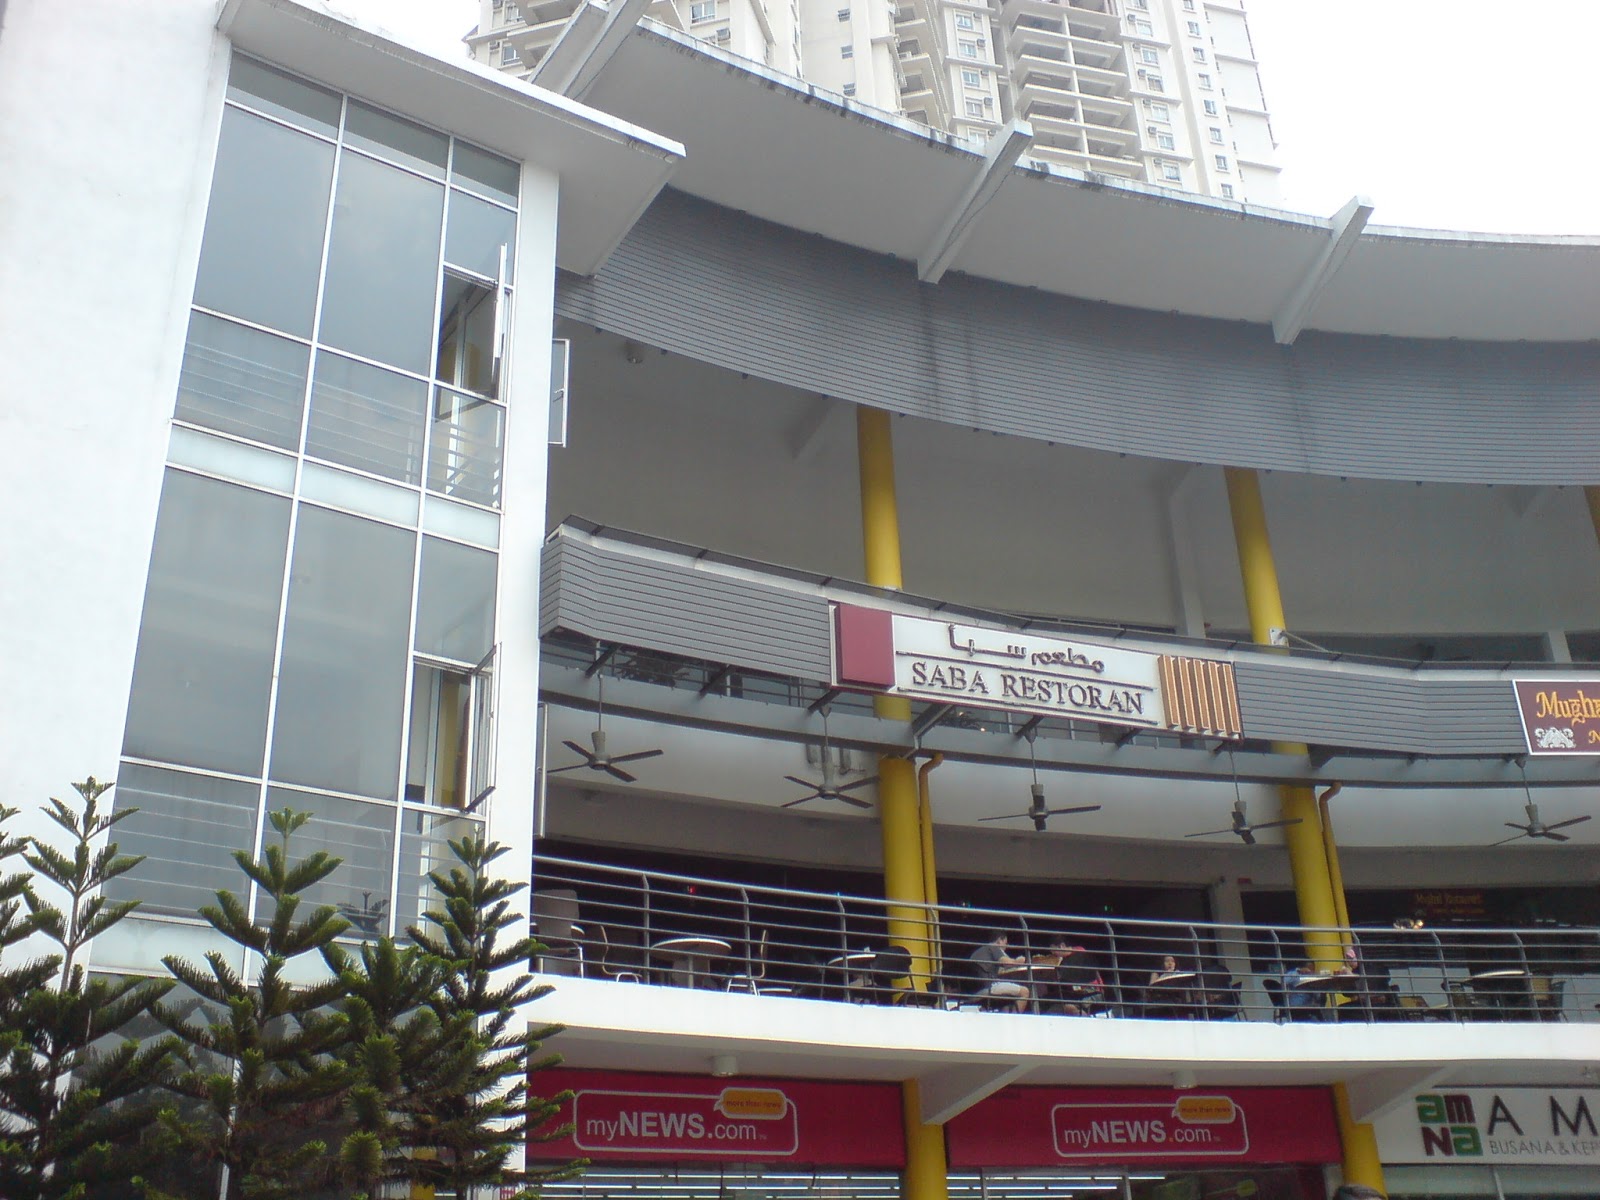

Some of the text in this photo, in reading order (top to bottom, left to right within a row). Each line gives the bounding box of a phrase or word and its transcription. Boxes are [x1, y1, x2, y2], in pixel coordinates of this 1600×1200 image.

[912, 661, 1144, 715] SABA RESTORAN
[586, 1111, 757, 1141] myNEWS.com
[1063, 1120, 1212, 1149] myNEWS.com
